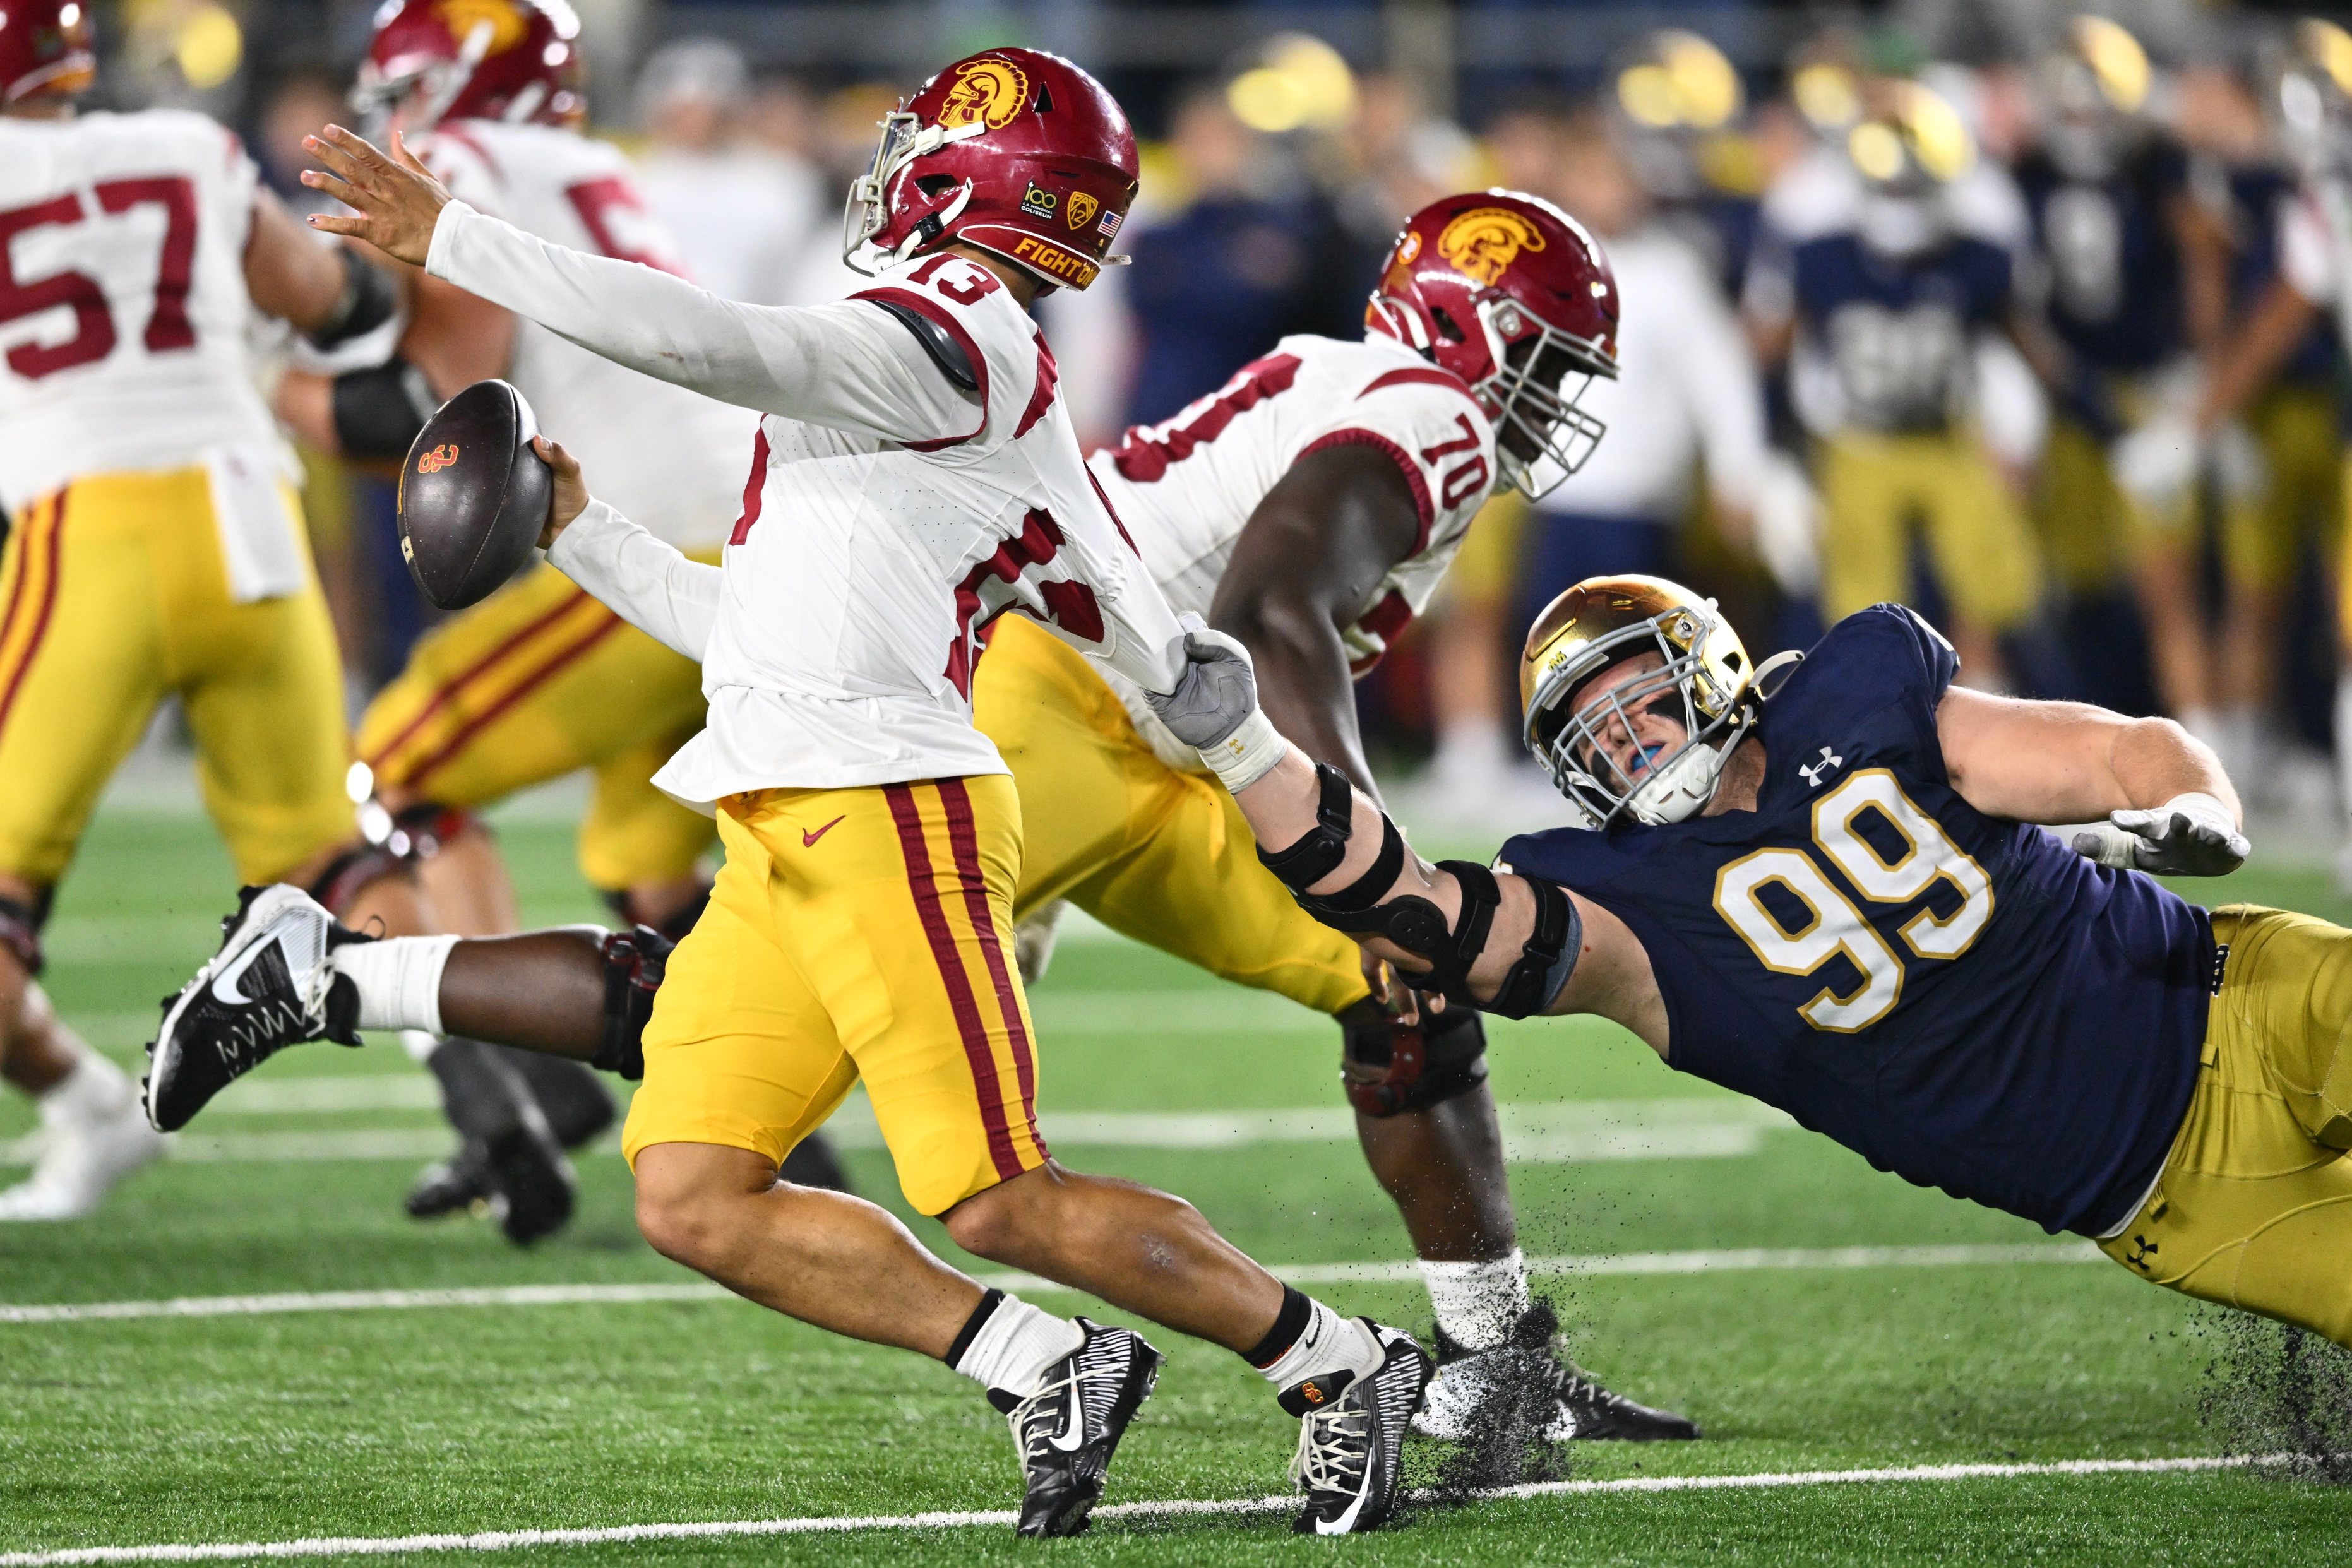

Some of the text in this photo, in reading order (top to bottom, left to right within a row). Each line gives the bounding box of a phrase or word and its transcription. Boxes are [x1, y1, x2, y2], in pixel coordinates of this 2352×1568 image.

[1021, 206, 1052, 219] COLISEUM
[1030, 205, 1053, 215] MEMORIAL
[1070, 194, 1096, 218] PAC
[1070, 208, 1086, 223] 12
[1013, 237, 1083, 277] FIGHT
[0, 176, 197, 380] 57
[906, 252, 1001, 306] 13
[1421, 412, 1489, 511] 70
[1712, 767, 1995, 1034] 99
